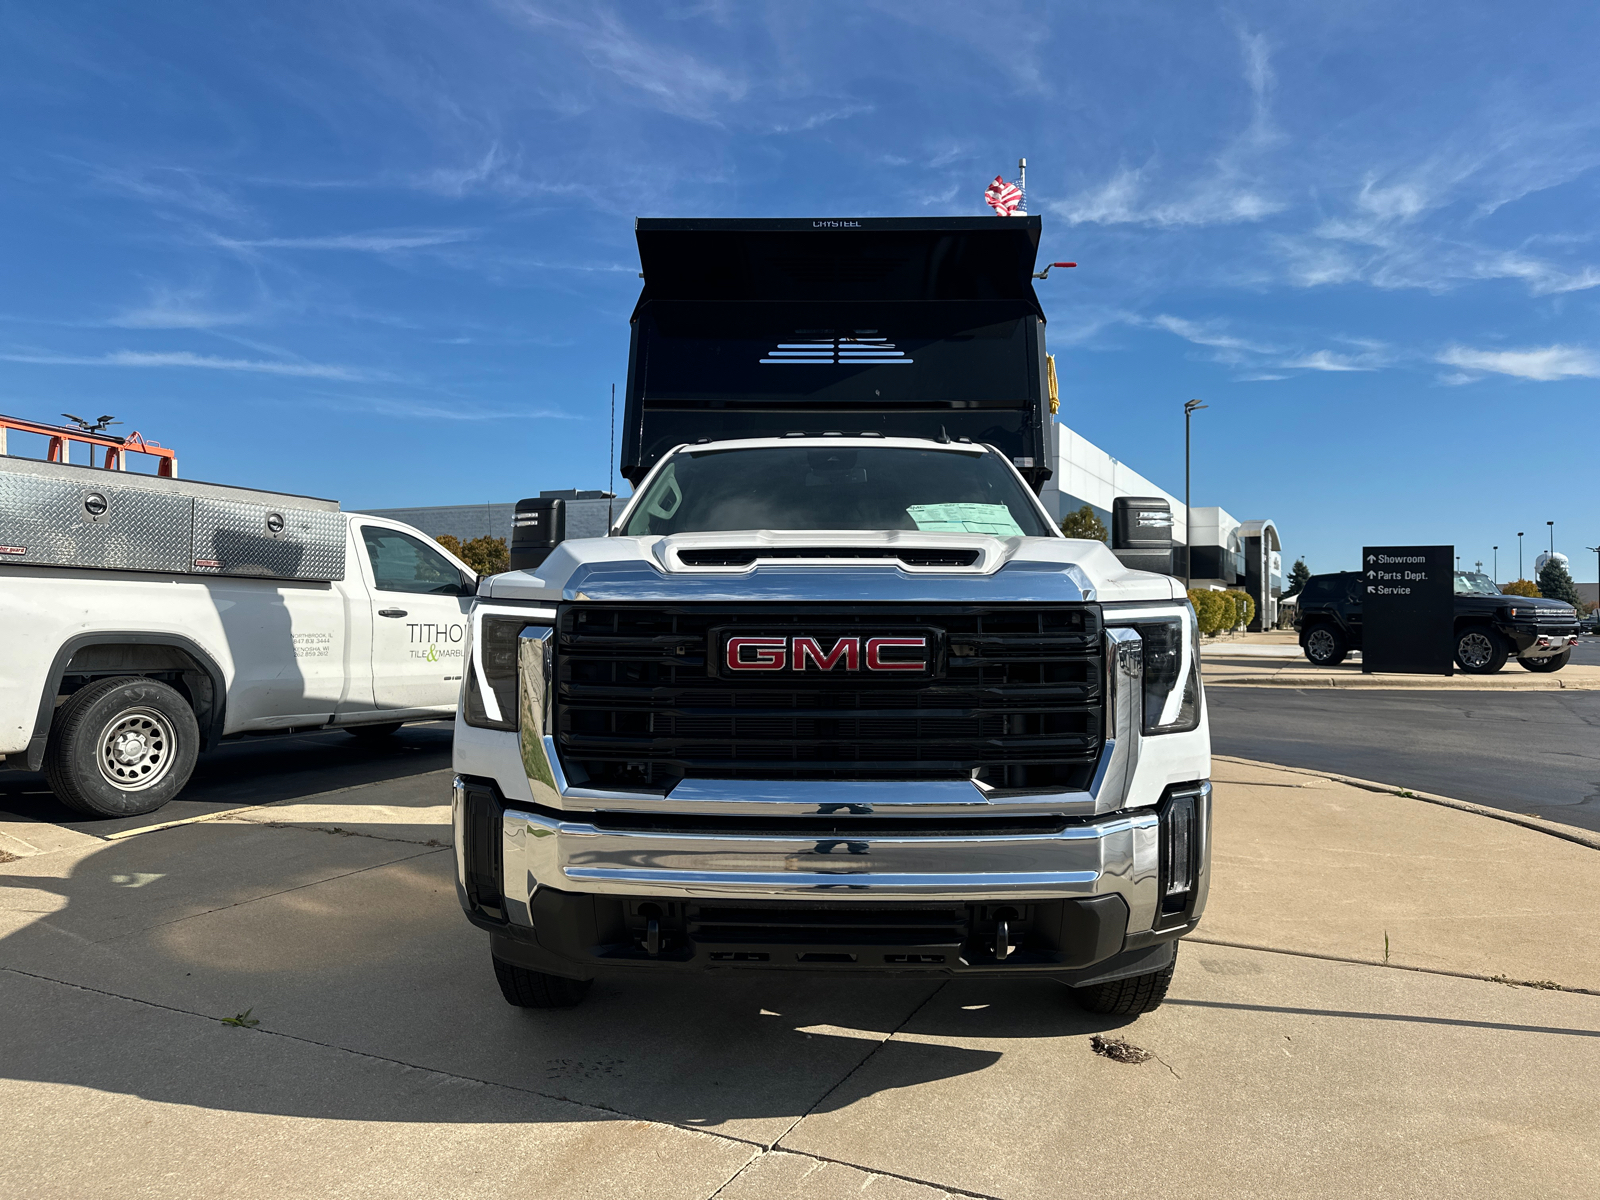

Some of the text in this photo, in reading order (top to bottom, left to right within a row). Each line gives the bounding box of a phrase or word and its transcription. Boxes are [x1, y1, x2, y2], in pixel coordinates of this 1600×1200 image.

[812, 220, 862, 228] CRYSTEEL
[1378, 554, 1426, 564] Showroom
[1377, 570, 1429, 582] Parts Dept.
[1377, 585, 1411, 595] Service
[406, 623, 467, 643] TITHO
[409, 650, 428, 658] TILE
[439, 649, 465, 658] MARBL
[726, 636, 926, 671] GMC
